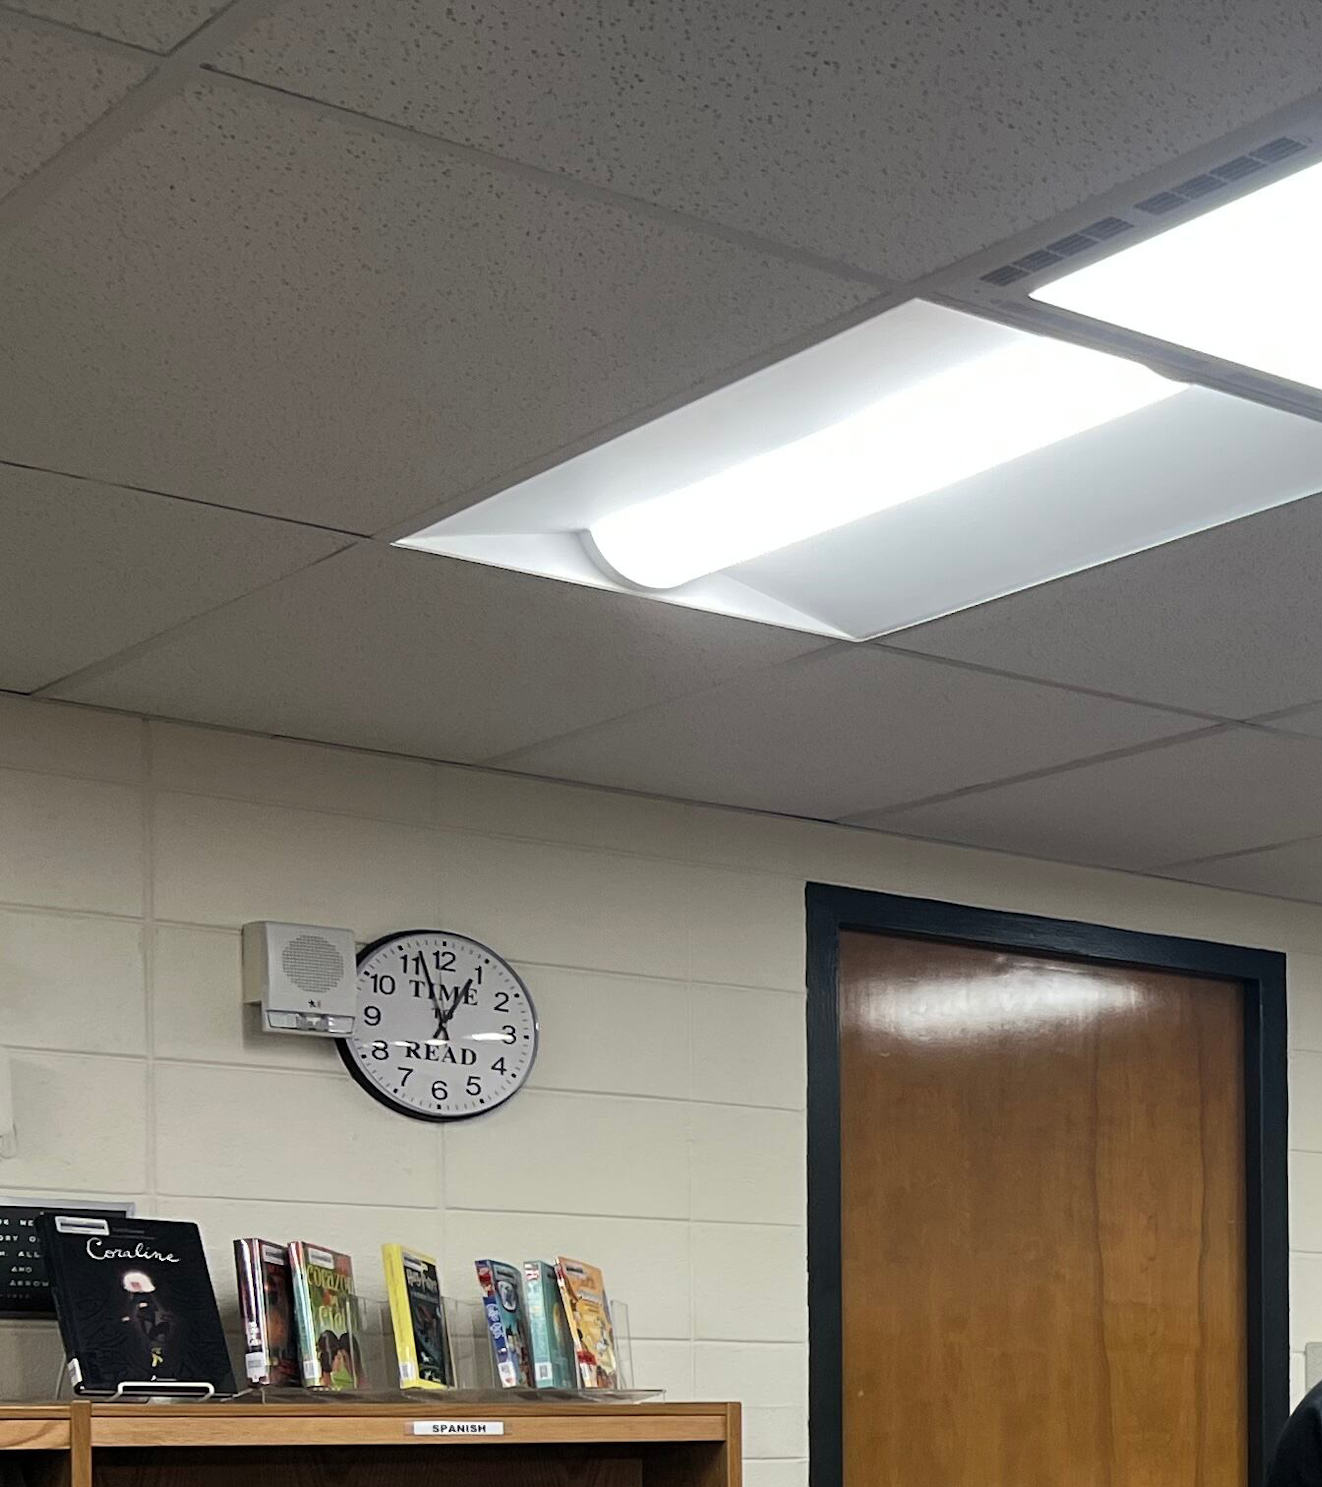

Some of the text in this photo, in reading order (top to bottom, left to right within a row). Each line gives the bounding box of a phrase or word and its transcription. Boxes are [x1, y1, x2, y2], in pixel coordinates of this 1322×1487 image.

[433, 951, 456, 972] 12
[475, 965, 482, 984] 1
[370, 974, 395, 995] 10
[409, 980, 478, 1005] TIME
[494, 992, 509, 1012] 2
[364, 1006, 381, 1025] 9
[502, 1026, 516, 1044] 3
[372, 1041, 389, 1060] 8
[405, 1042, 476, 1066] READ
[491, 1057, 507, 1075] 4
[398, 1067, 413, 1086] 7
[466, 1076, 481, 1095] 5
[432, 1081, 447, 1100] 6
[86, 1237, 180, 1262] Coraline
[432, 1424, 487, 1433] SPANISH
